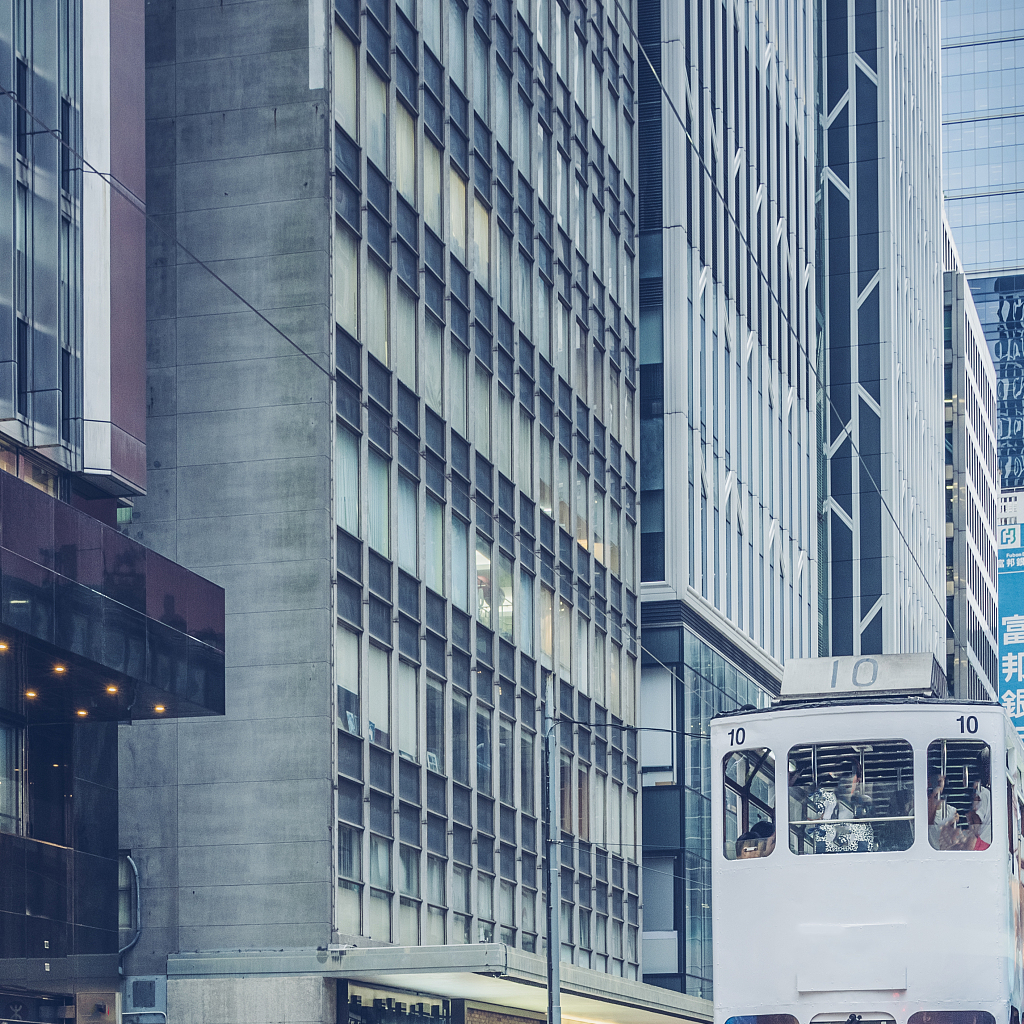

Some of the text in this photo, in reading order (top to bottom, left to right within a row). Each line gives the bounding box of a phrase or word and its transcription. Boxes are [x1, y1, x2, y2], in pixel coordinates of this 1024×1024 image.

[830, 657, 879, 689] 10
[956, 715, 979, 734] 10
[727, 727, 746, 746] 10
